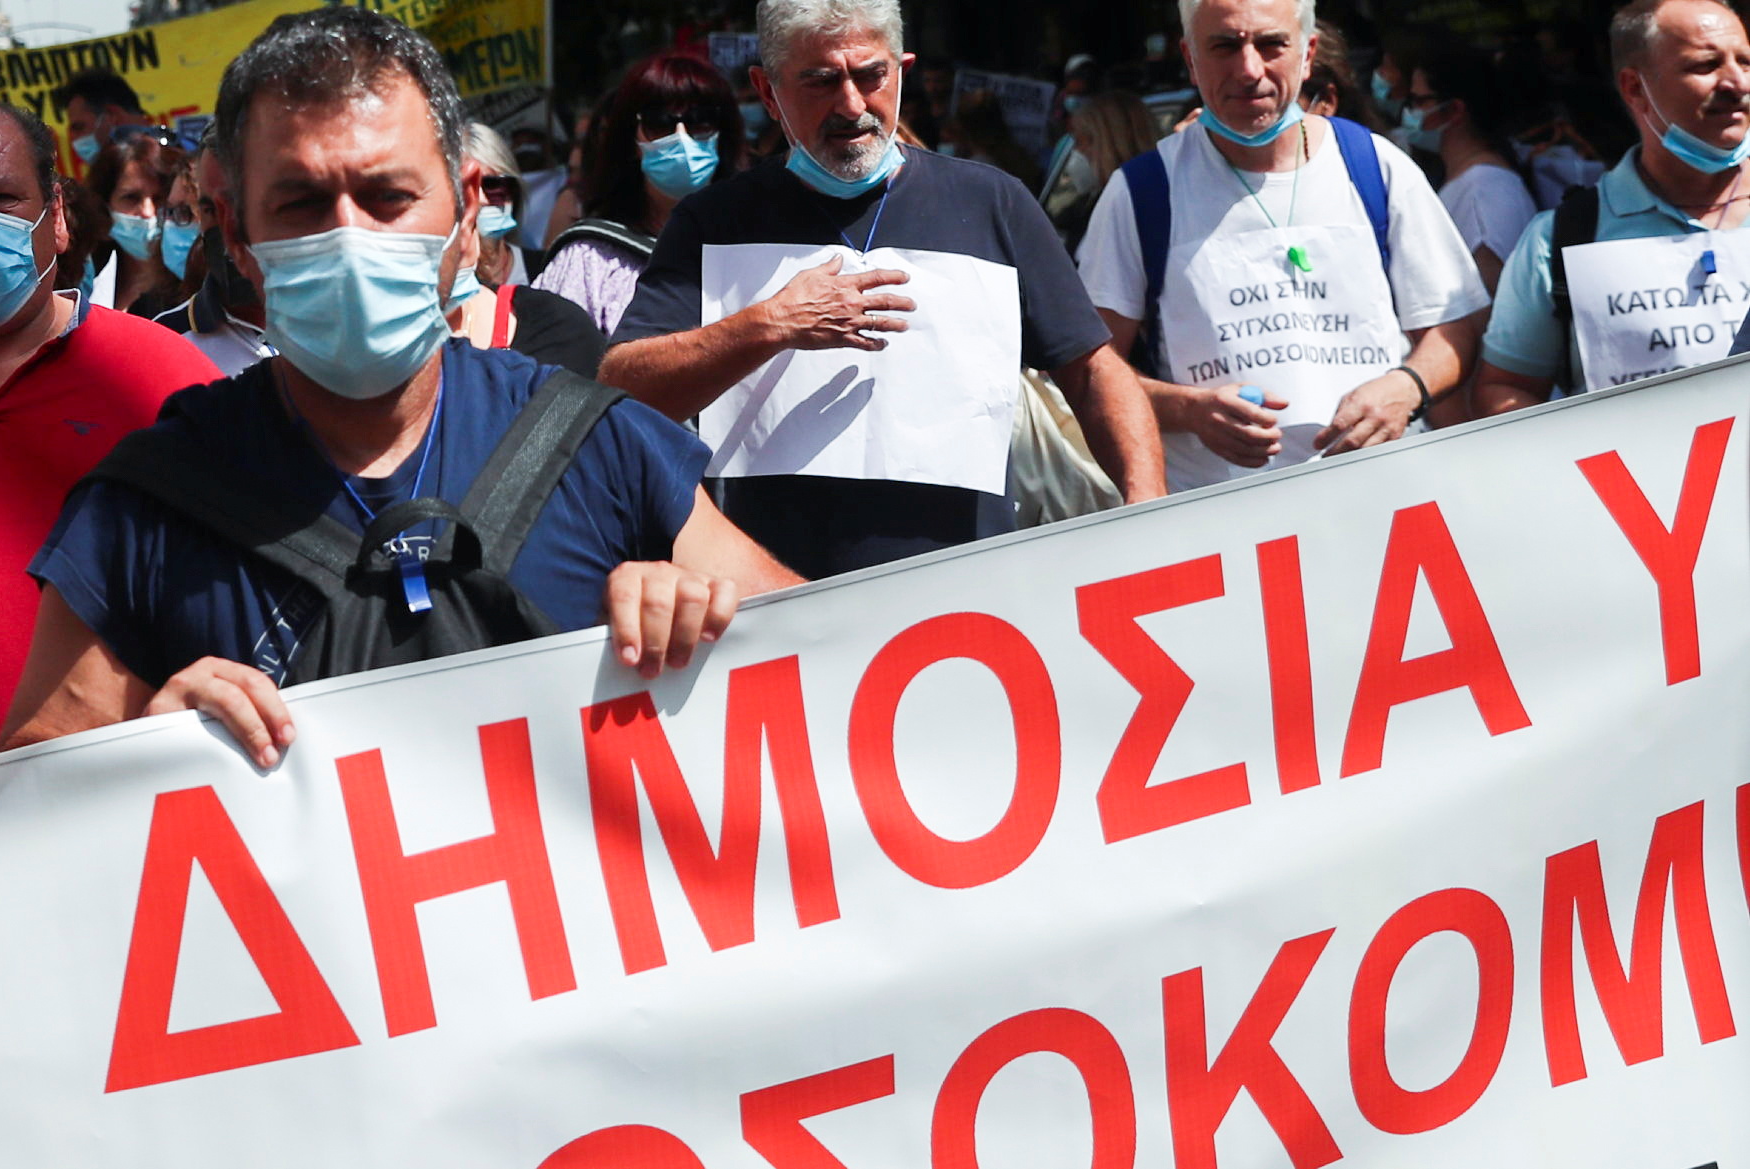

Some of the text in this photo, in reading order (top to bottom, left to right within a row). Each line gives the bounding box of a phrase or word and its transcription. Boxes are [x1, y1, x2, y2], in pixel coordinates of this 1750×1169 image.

[1229, 283, 1269, 307] ΟΧΙ
[1607, 287, 1688, 316] ΚΑΤΩ
[1692, 281, 1732, 306] ΤΑ
[1217, 311, 1350, 343] ΣΥΓΧΩΝΕΥΣΗ
[1648, 323, 1716, 352] ΑΠΟ
[1187, 357, 1230, 383] ΤΩΝ
[105, 501, 1534, 1094] ΔΗΜΟΣΙΑ
